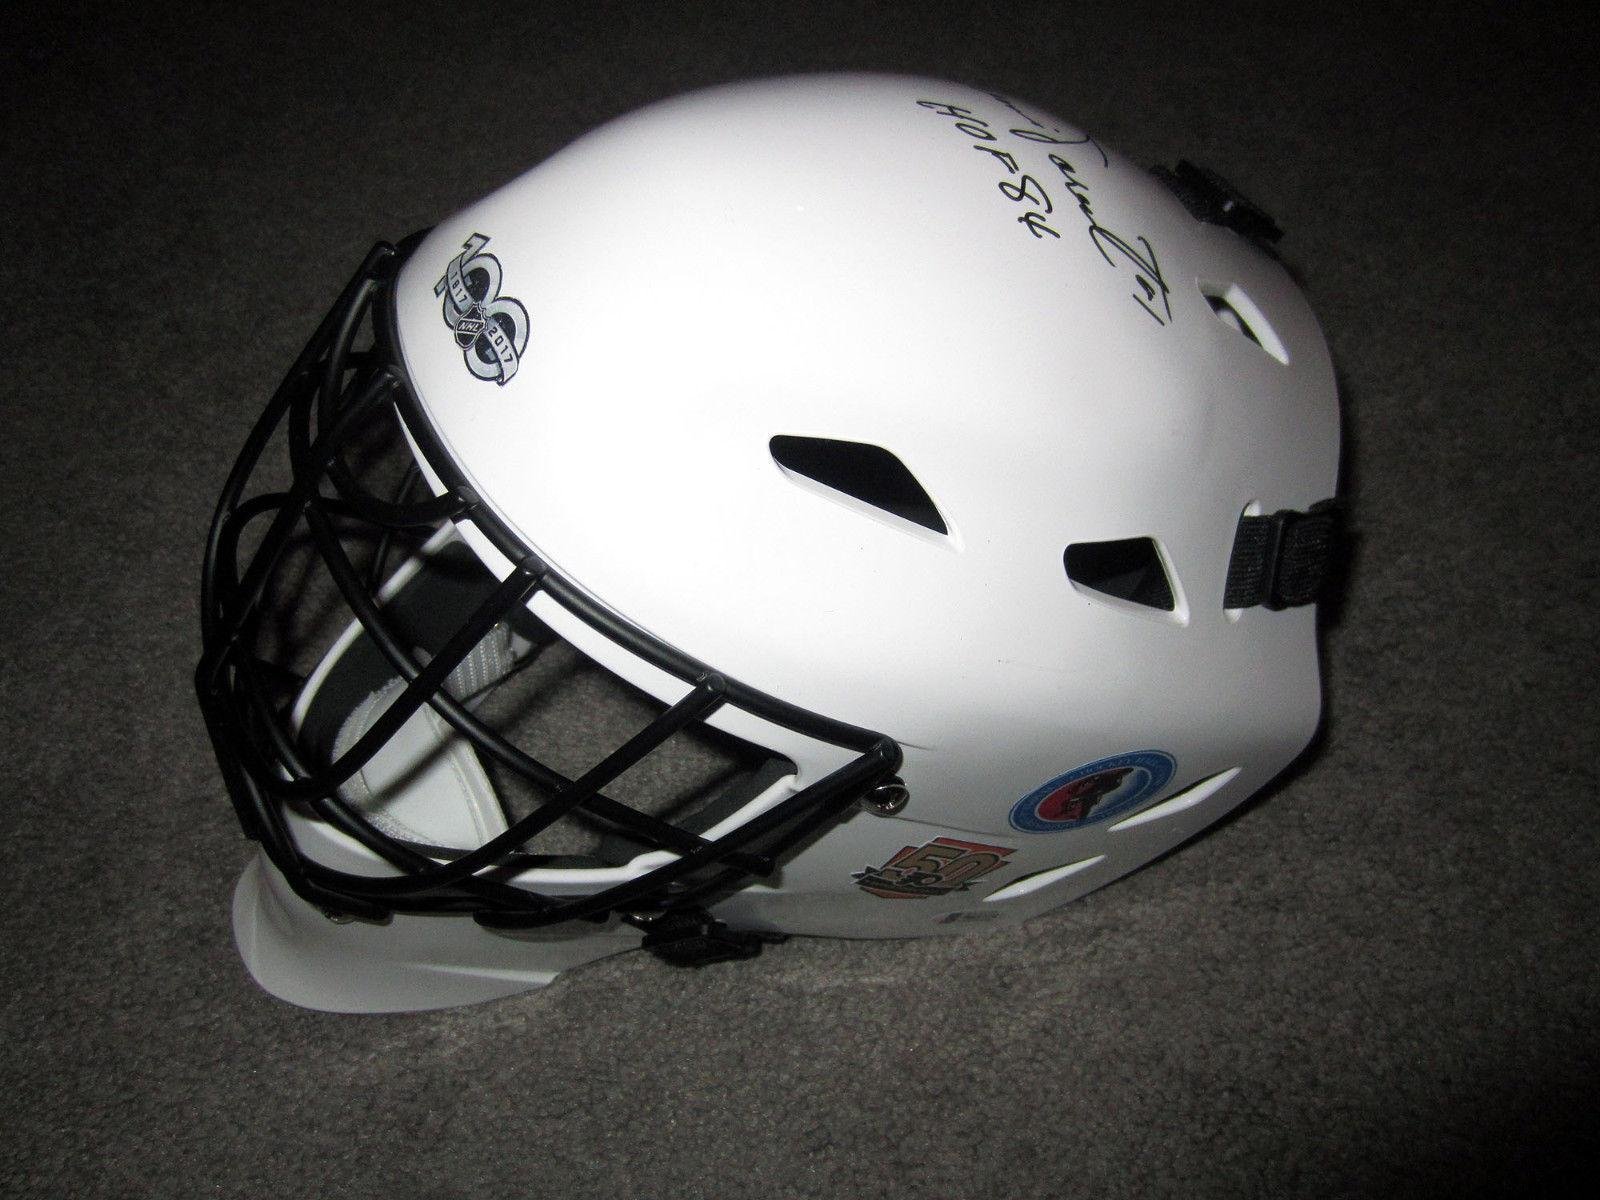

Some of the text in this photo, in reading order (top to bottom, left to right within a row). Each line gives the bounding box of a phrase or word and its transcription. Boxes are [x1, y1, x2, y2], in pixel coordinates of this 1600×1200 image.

[916, 100, 1019, 174] HOF
[998, 174, 1061, 239] 84
[458, 321, 484, 333] NHL
[487, 326, 514, 363] 2017
[888, 842, 1001, 888] 50
